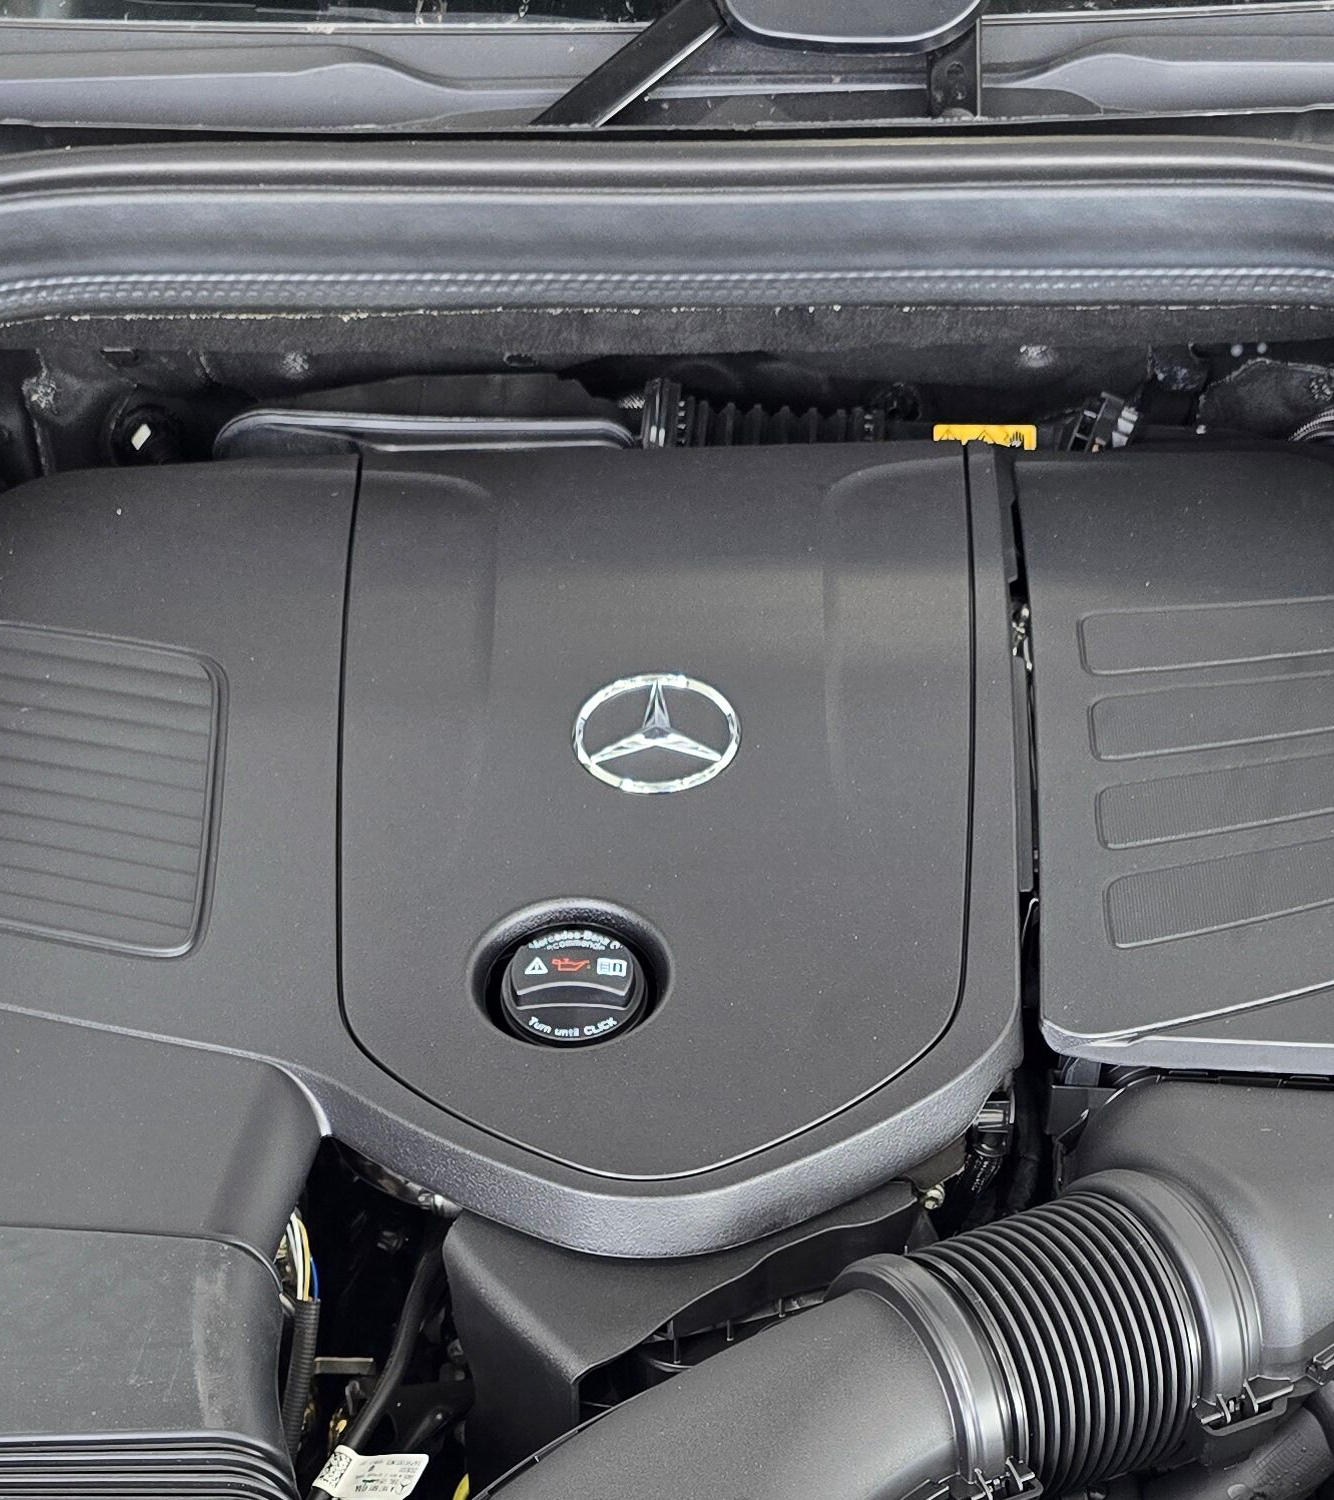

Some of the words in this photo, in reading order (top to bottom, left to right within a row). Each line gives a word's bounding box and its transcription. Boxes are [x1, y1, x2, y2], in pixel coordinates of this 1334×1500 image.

[528, 1016, 552, 1034] Turn
[554, 1027, 580, 1037] until
[583, 1017, 618, 1036] CLICK
